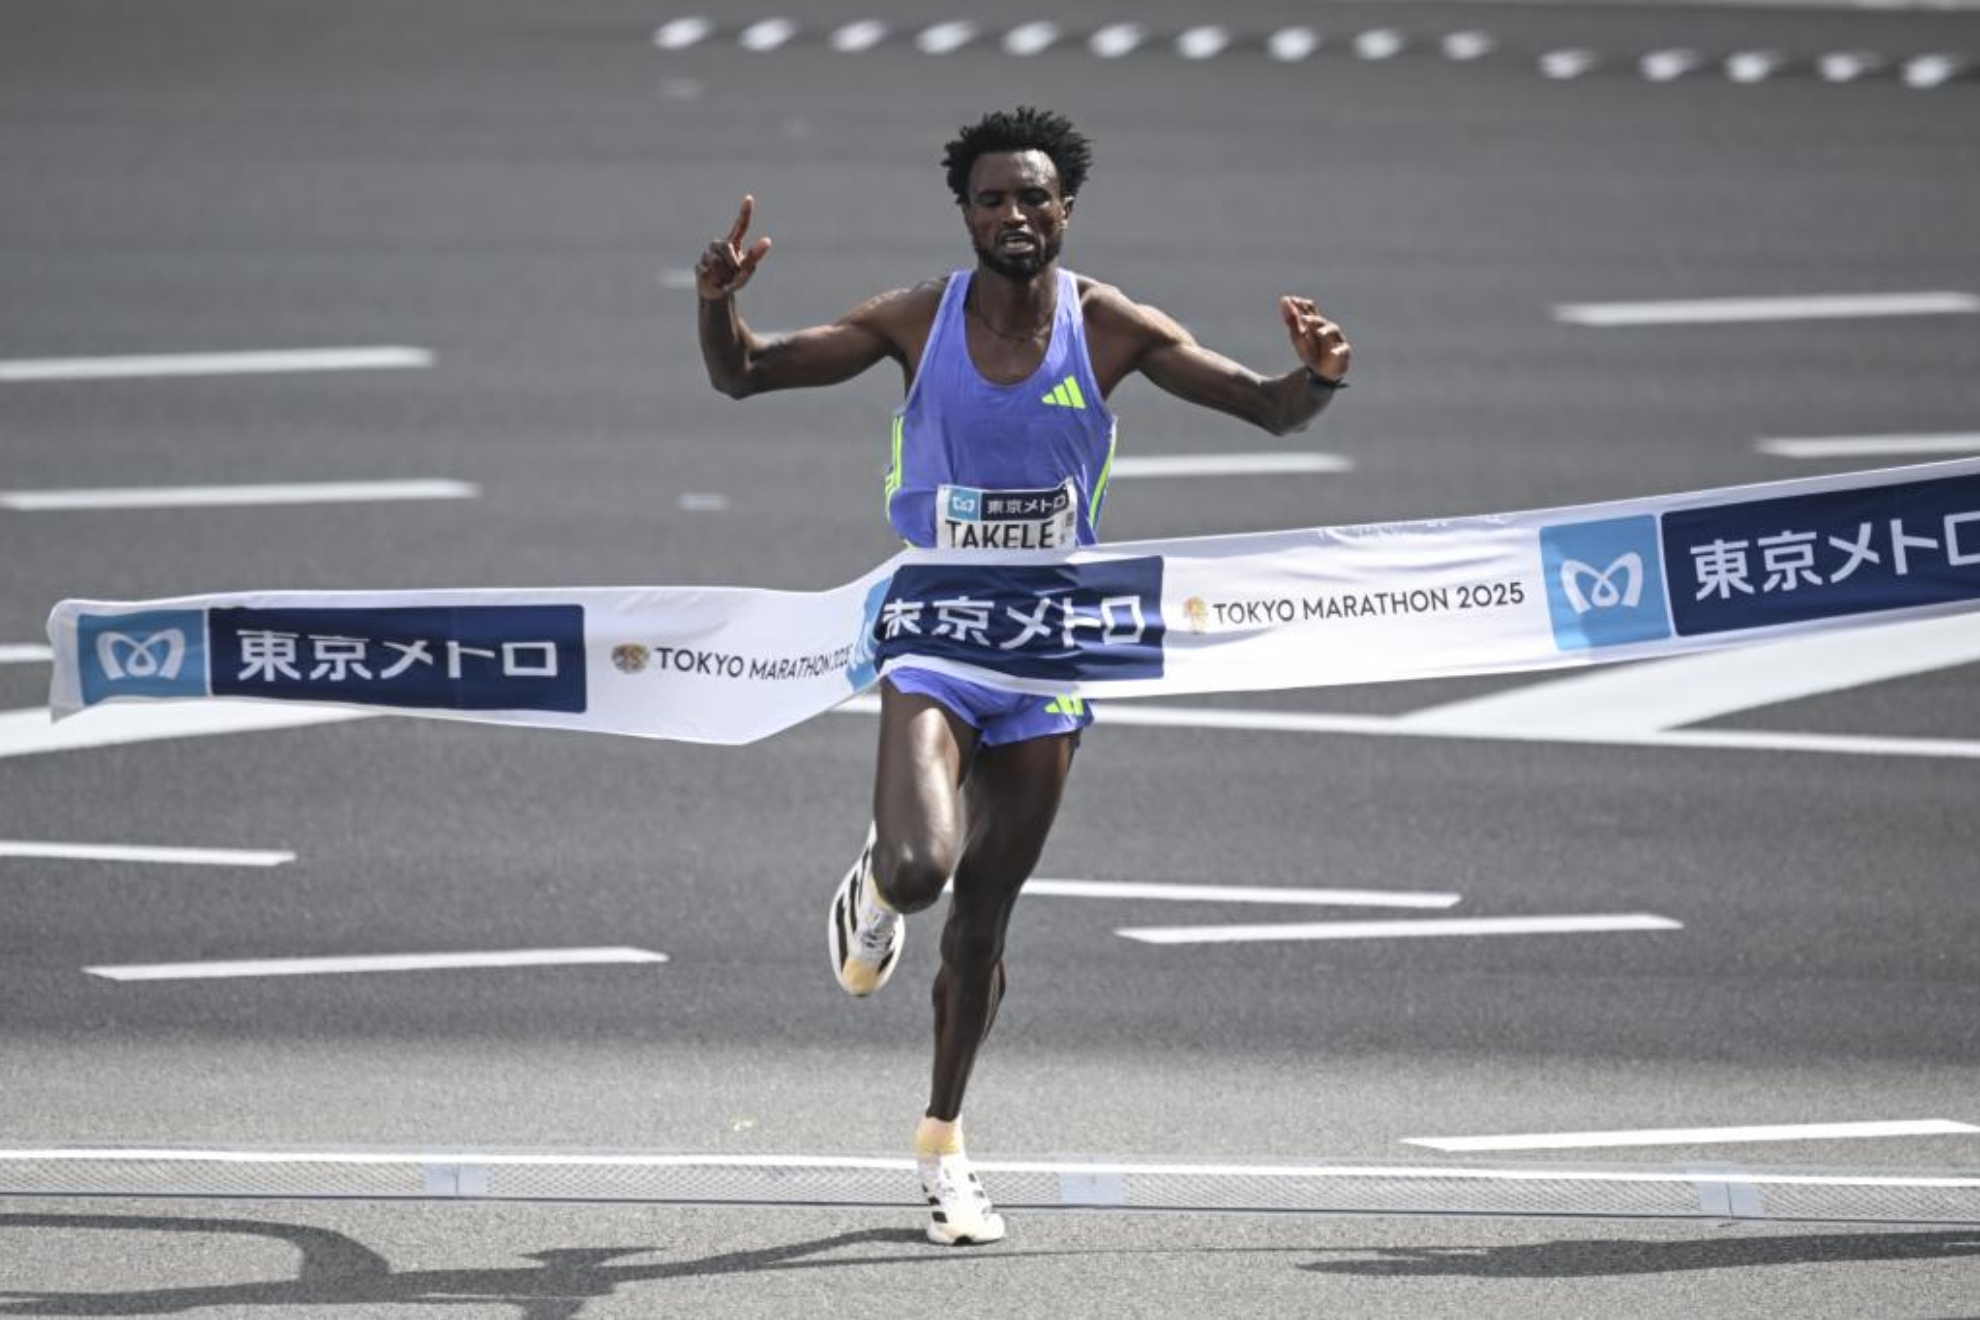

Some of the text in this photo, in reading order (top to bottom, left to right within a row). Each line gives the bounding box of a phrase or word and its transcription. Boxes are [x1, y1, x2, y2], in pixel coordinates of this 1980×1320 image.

[987, 494, 1066, 514] 東京メトロ
[945, 519, 1054, 549] TAKELE
[1690, 510, 1980, 601] 東京メトロ
[1213, 582, 1525, 625] TOKYO MARATHON 2025
[236, 629, 558, 682] 東京メトロ
[655, 647, 745, 679] TOKYO
[748, 654, 833, 680] MARATHON
